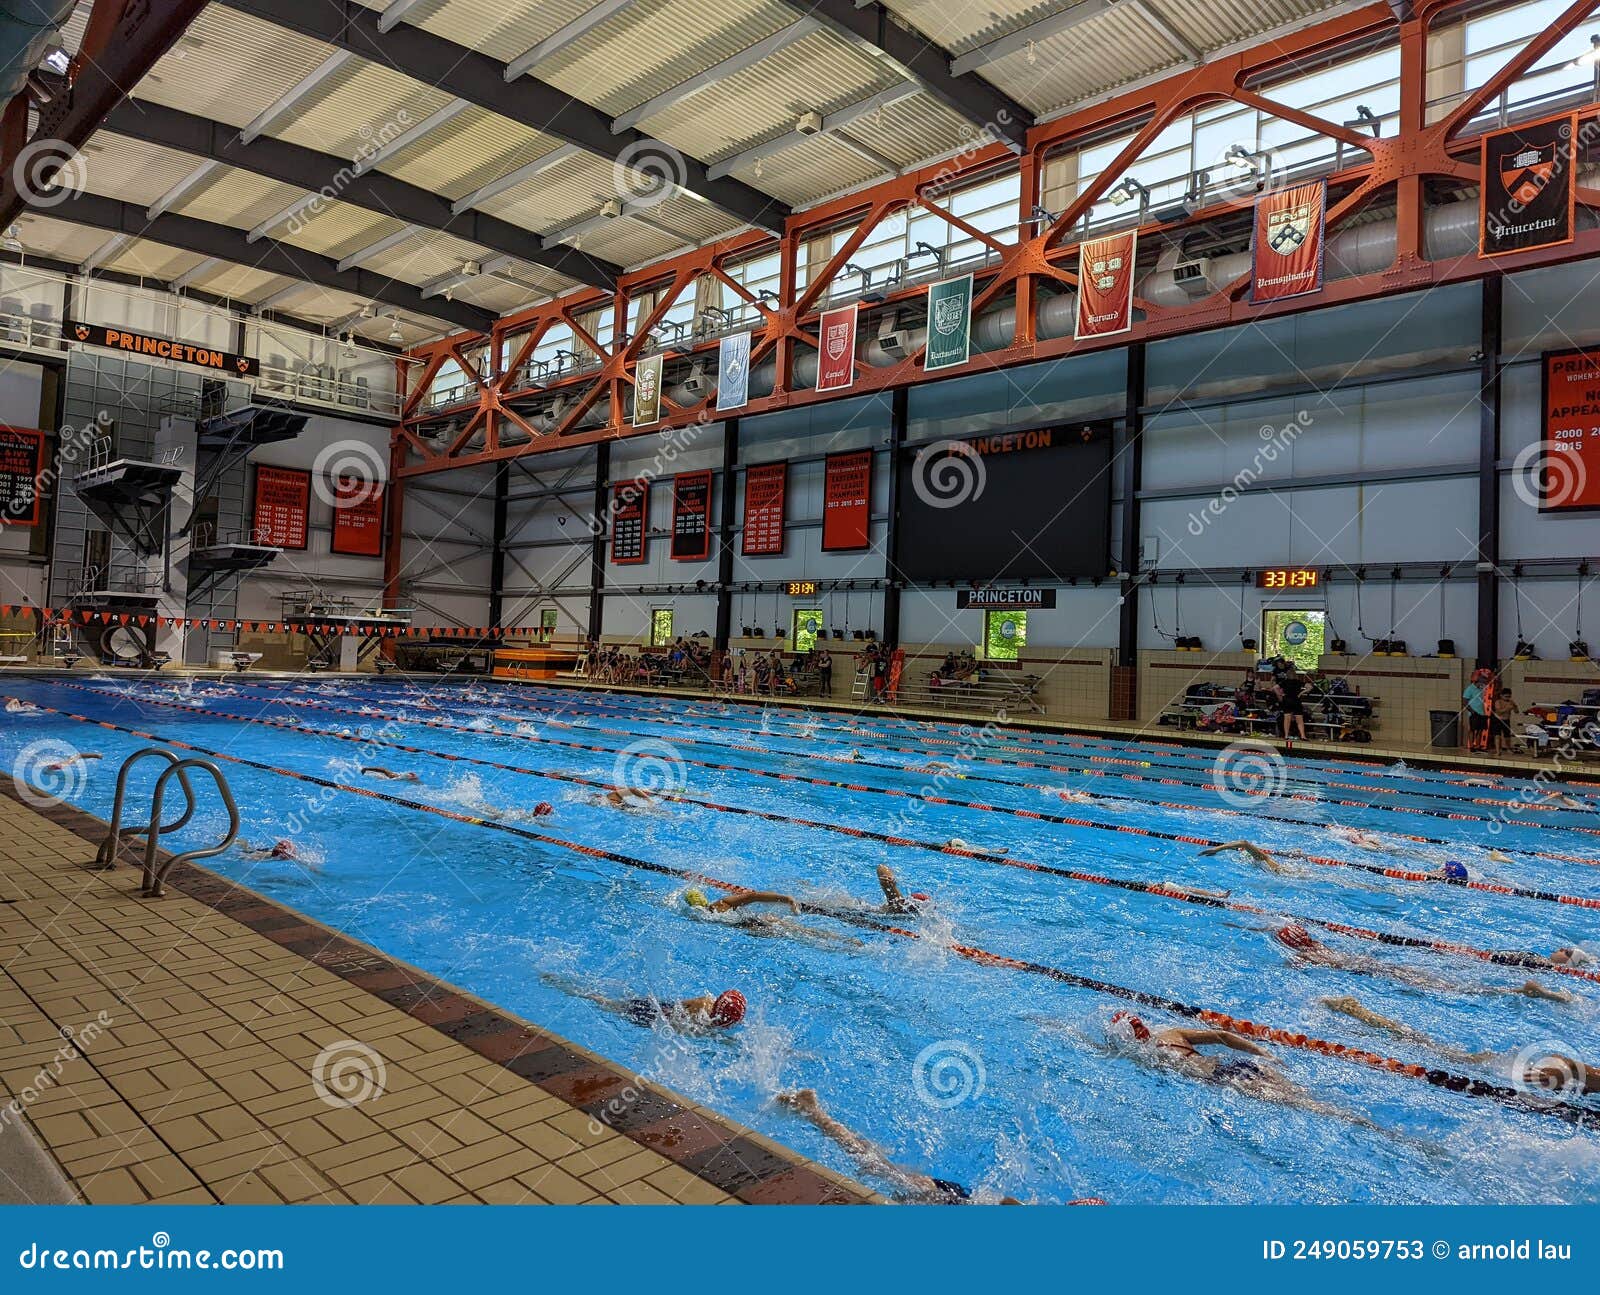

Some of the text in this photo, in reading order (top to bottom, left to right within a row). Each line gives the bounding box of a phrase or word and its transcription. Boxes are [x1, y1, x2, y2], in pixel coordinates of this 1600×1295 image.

[1494, 217, 1556, 240] Princeton
[1257, 269, 1315, 289] Pennsylvania
[1088, 310, 1119, 324] Harvard
[105, 329, 224, 368] PRINCETON
[930, 346, 963, 360] Dartmouth
[1555, 428, 1583, 439] 2000
[949, 430, 1052, 457] PRINCETON
[1555, 441, 1583, 451] 2015
[969, 590, 1042, 603] PRINCETON
